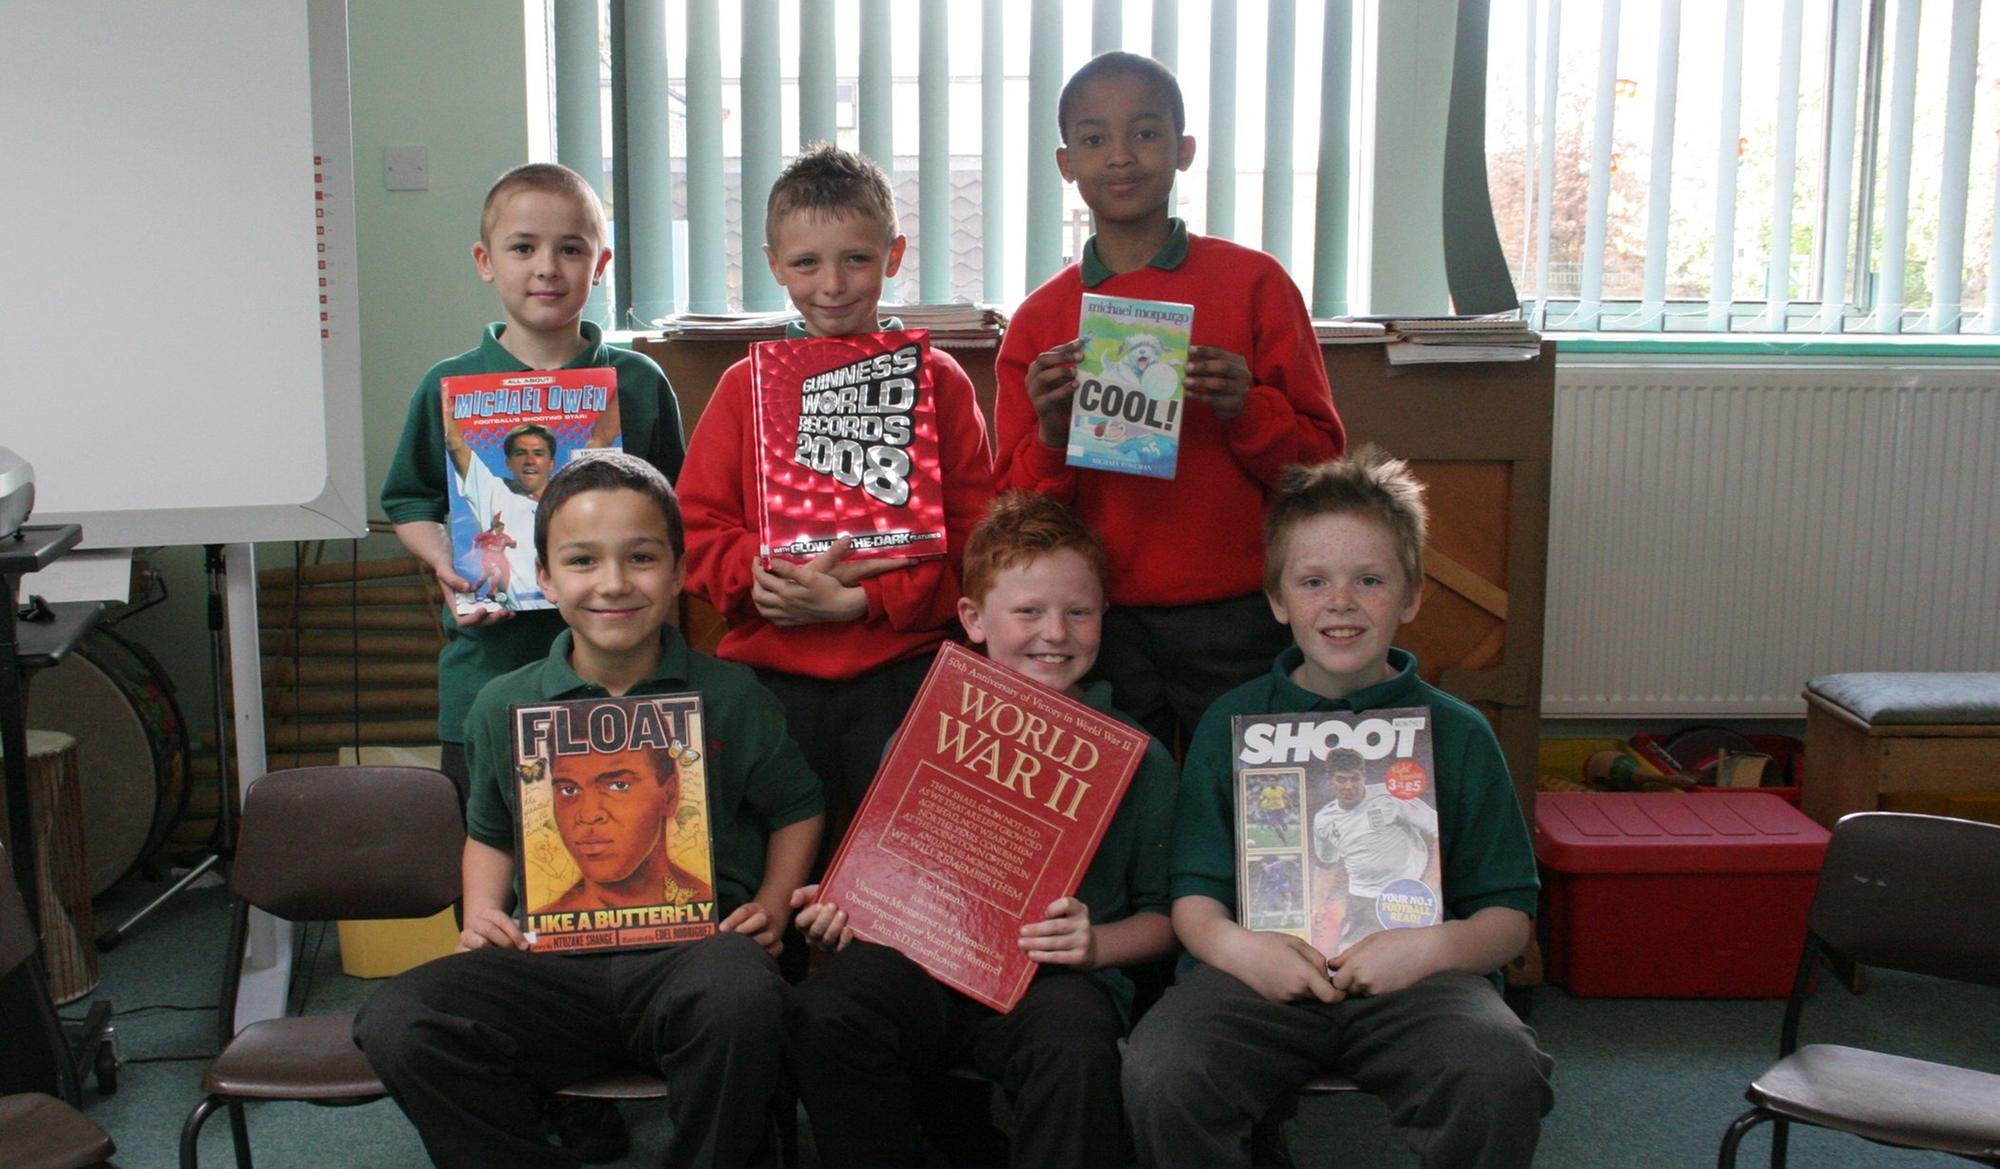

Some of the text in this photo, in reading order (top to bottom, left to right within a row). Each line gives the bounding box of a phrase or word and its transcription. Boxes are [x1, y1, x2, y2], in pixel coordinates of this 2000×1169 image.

[1088, 302, 1190, 326] michael morpurgo
[802, 346, 918, 393] GUINNESS
[454, 384, 608, 419] MICHAEL OWEN
[801, 377, 915, 415] WORLD
[1079, 379, 1179, 432] COOL!
[473, 416, 521, 426] FOOTBALL'S
[522, 415, 562, 423] SHOOTING
[798, 415, 911, 446] RECORDS
[794, 433, 911, 507] 2008
[947, 657, 967, 671] 50th
[968, 668, 1019, 697] Anniversary
[1020, 692, 1031, 701] of
[1031, 697, 1061, 717] Victory
[1064, 713, 1074, 722] in
[1075, 718, 1101, 735] World
[1103, 732, 1121, 745] War
[520, 700, 698, 759] FLOAT
[960, 681, 1099, 772] WORLD
[1239, 717, 1425, 765] SHOOT
[936, 711, 1093, 822] WAR II
[1388, 778, 1397, 791] 3
[1405, 778, 1421, 791] £5
[919, 786, 930, 796] AS
[944, 798, 965, 812] THAT
[964, 808, 982, 821] ARE
[999, 825, 1025, 842] GROW
[1024, 838, 1042, 851] OLD
[930, 780, 1040, 839] THEY SHALL GROW NOT OLD
[957, 838, 985, 857] DOWN
[960, 817, 979, 831] NOT
[978, 827, 1010, 846] WEARY
[1008, 842, 1034, 858] THEM
[890, 828, 1024, 900] WE WILL REMEMBER THEM
[528, 902, 713, 934] LIKE A BUTTERFLY
[1382, 893, 1433, 907] YOUR NO.1
[1382, 902, 1430, 916] FOOTBALL
[871, 919, 893, 937] John
[962, 949, 1003, 976] Rommel
